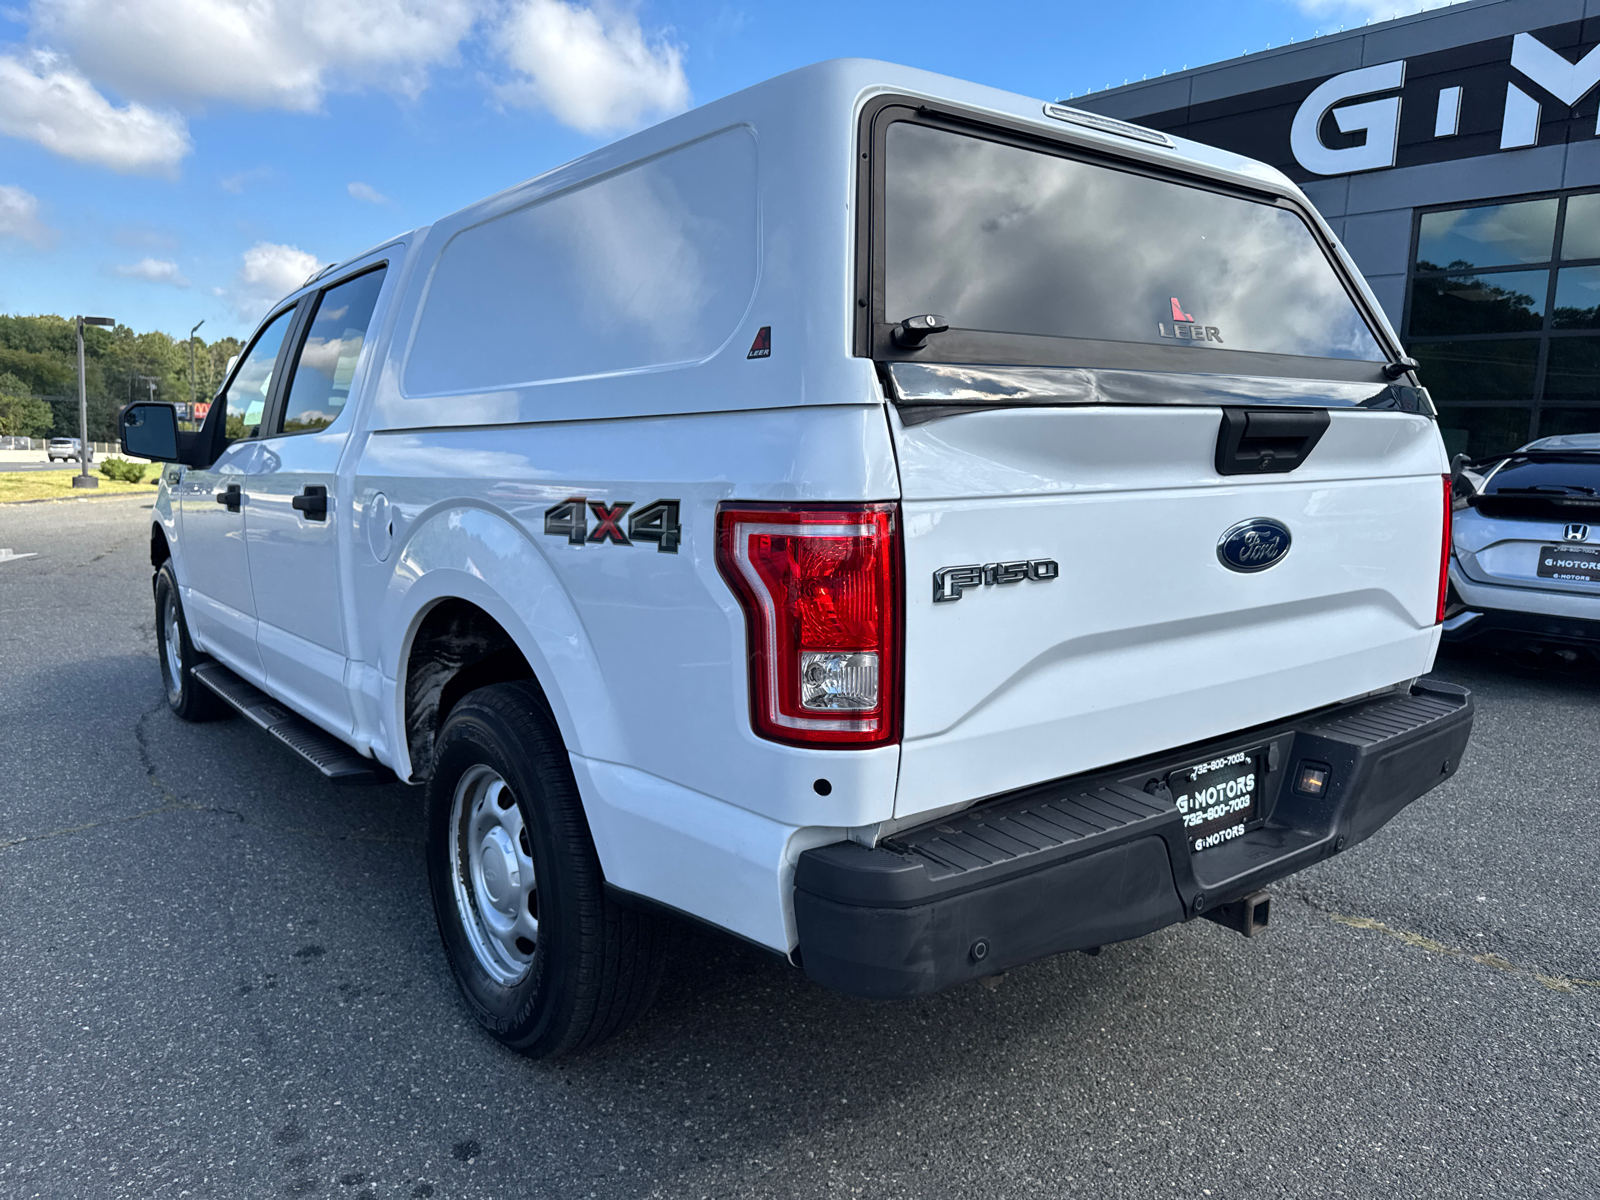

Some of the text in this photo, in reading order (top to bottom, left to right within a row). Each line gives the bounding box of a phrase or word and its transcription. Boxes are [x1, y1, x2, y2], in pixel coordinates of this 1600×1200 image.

[1158, 322, 1224, 343] LEER
[749, 349, 770, 357] LEER
[1239, 530, 1280, 562] Ford
[932, 557, 1059, 603] F150
[1193, 752, 1245, 776] 732-800-7003
[1182, 794, 1251, 828] 732-800-7003
